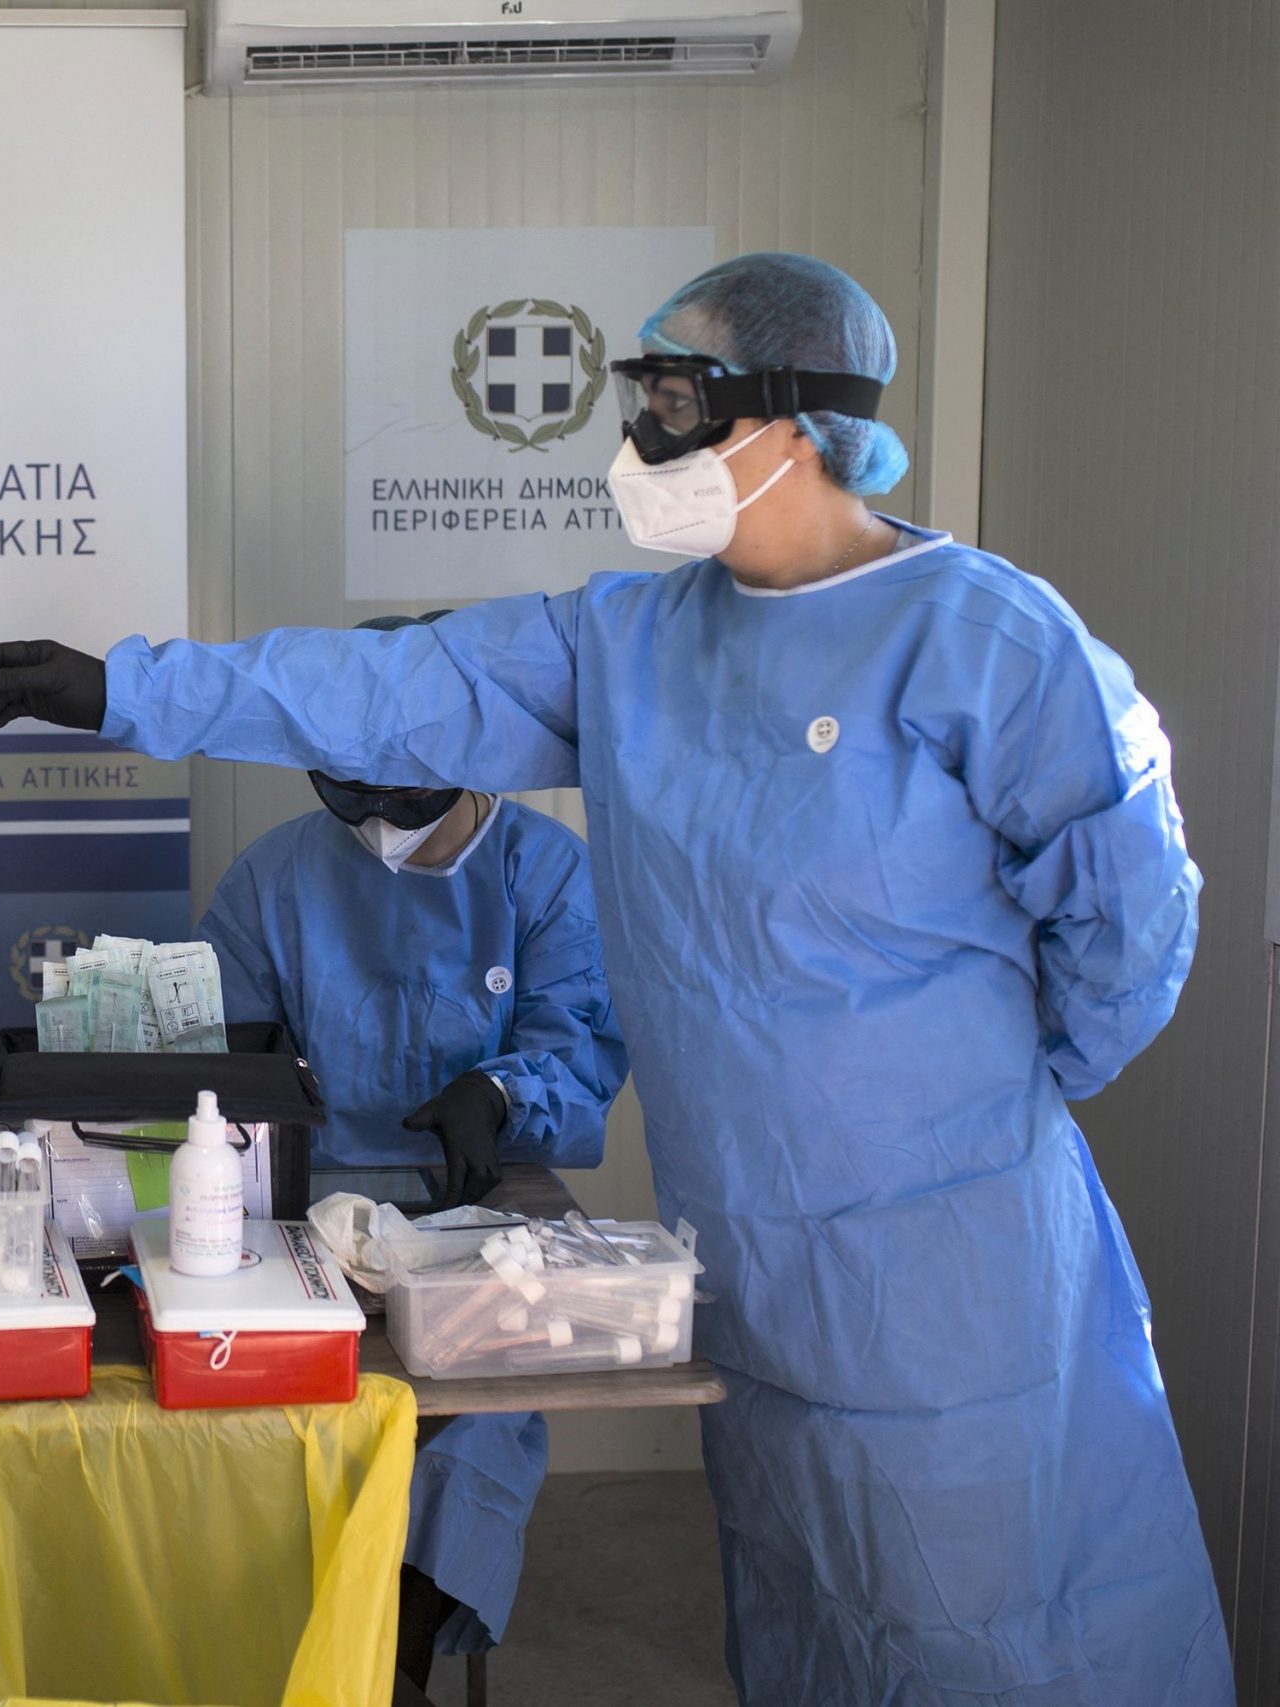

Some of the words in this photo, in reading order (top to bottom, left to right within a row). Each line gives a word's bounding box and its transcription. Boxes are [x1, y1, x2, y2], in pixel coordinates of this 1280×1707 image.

[372, 477, 504, 502] ΕΛΛΗΝΙΚΗ
[518, 476, 612, 500] ΔΗΜΟΚ
[372, 508, 548, 532] ΠΕΡΙΦΕΡΕΙΑ
[564, 507, 624, 531] ΑΤΤΙ
[22, 766, 139, 789] ΑΤΤΙΚΗΣ
